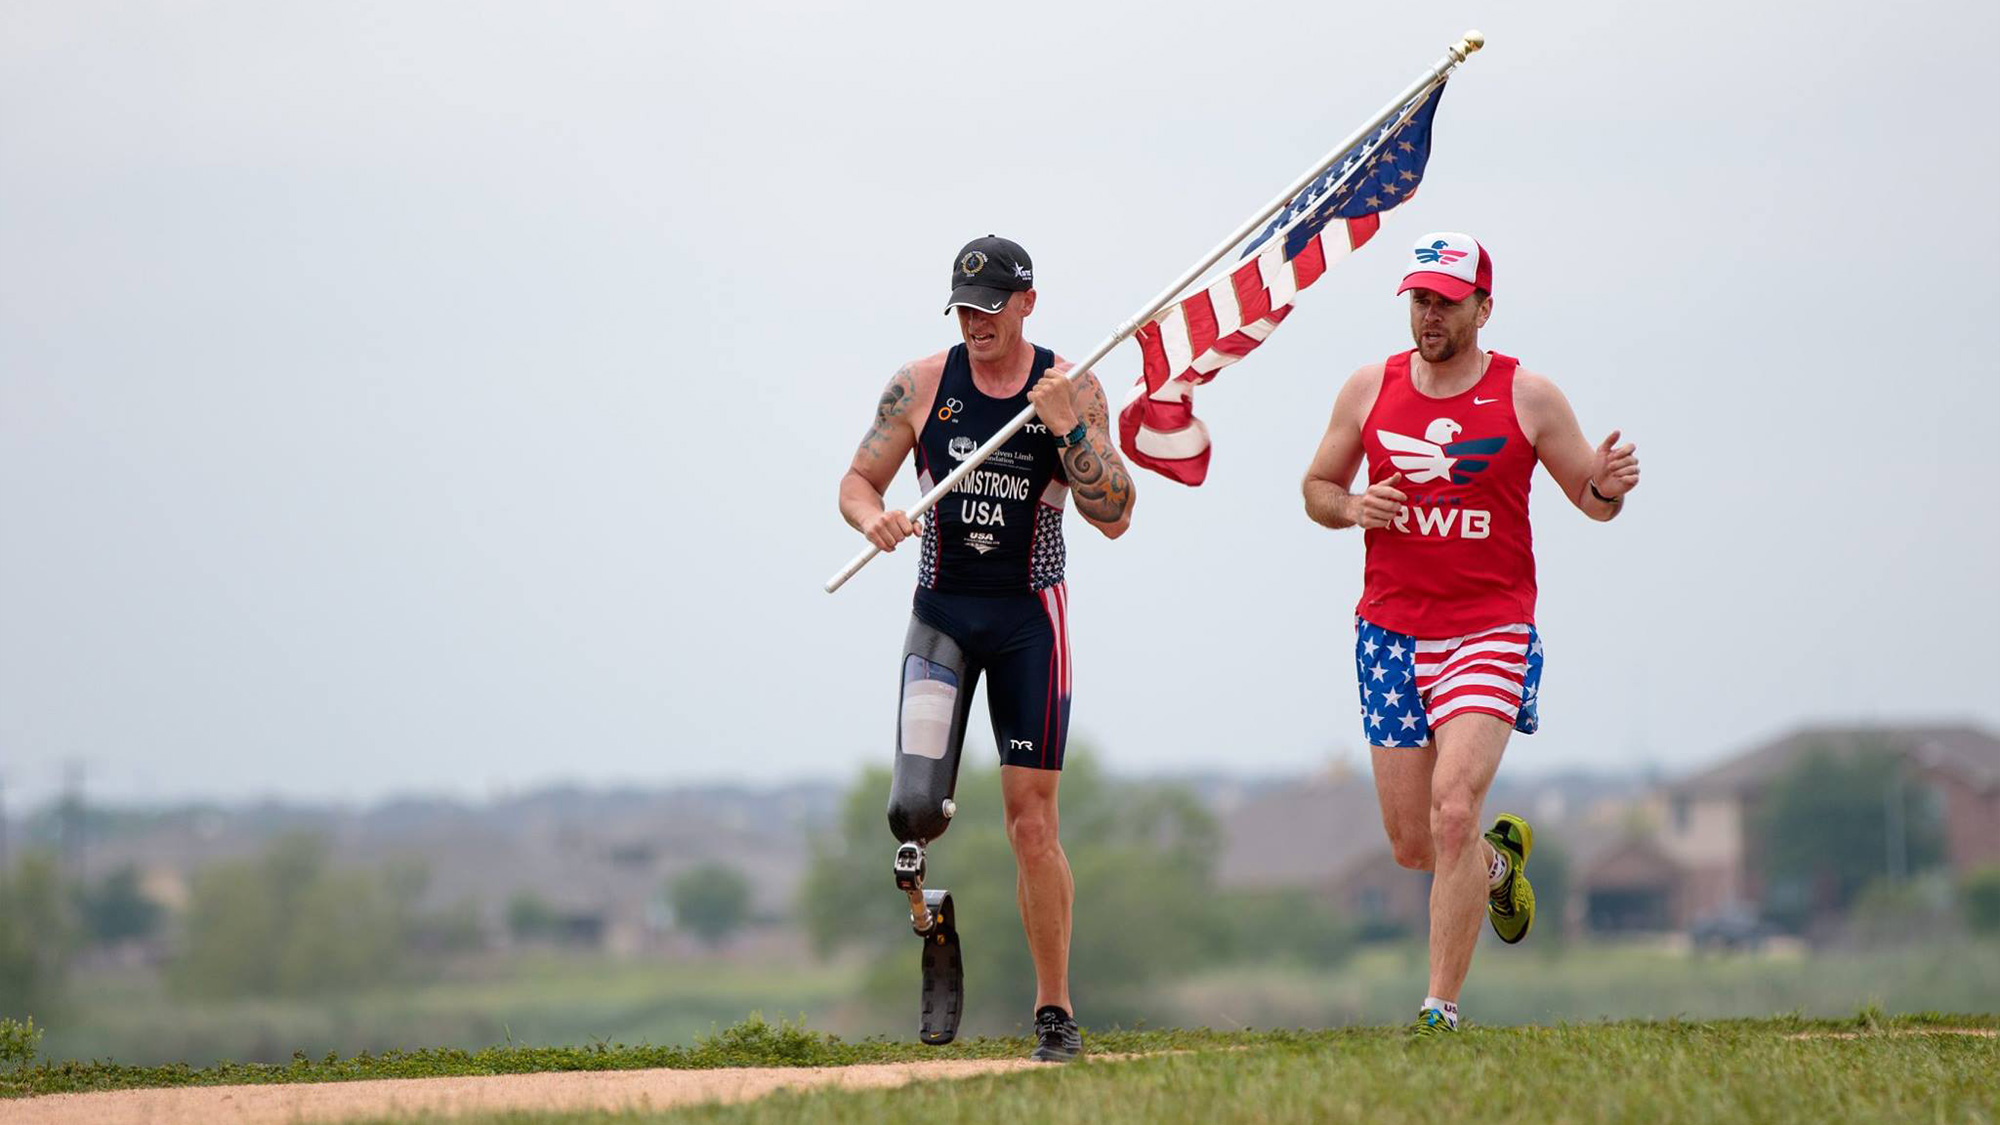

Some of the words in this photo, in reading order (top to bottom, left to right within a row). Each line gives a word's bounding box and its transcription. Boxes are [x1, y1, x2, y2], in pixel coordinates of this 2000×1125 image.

[1025, 423, 1046, 434] TYR
[961, 499, 1005, 527] USA
[1385, 505, 1491, 539] RWB
[970, 532, 994, 541] USA
[1010, 739, 1033, 751] TYR
